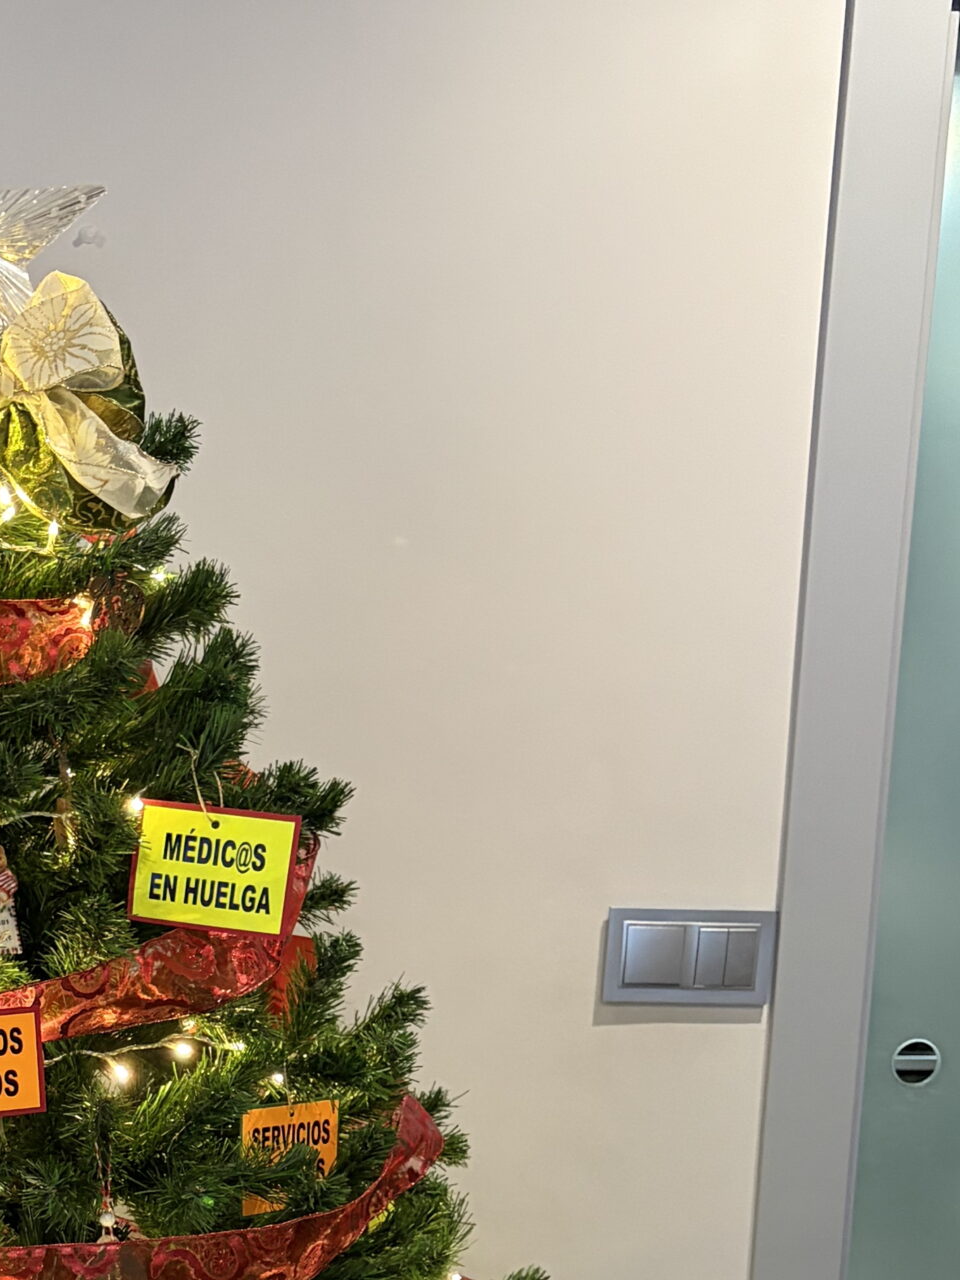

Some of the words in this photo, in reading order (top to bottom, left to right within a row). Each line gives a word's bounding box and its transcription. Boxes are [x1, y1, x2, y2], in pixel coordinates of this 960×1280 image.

[162, 828, 267, 874] MÉDIC@S
[148, 872, 179, 903] EN
[183, 876, 271, 915] HUELGA
